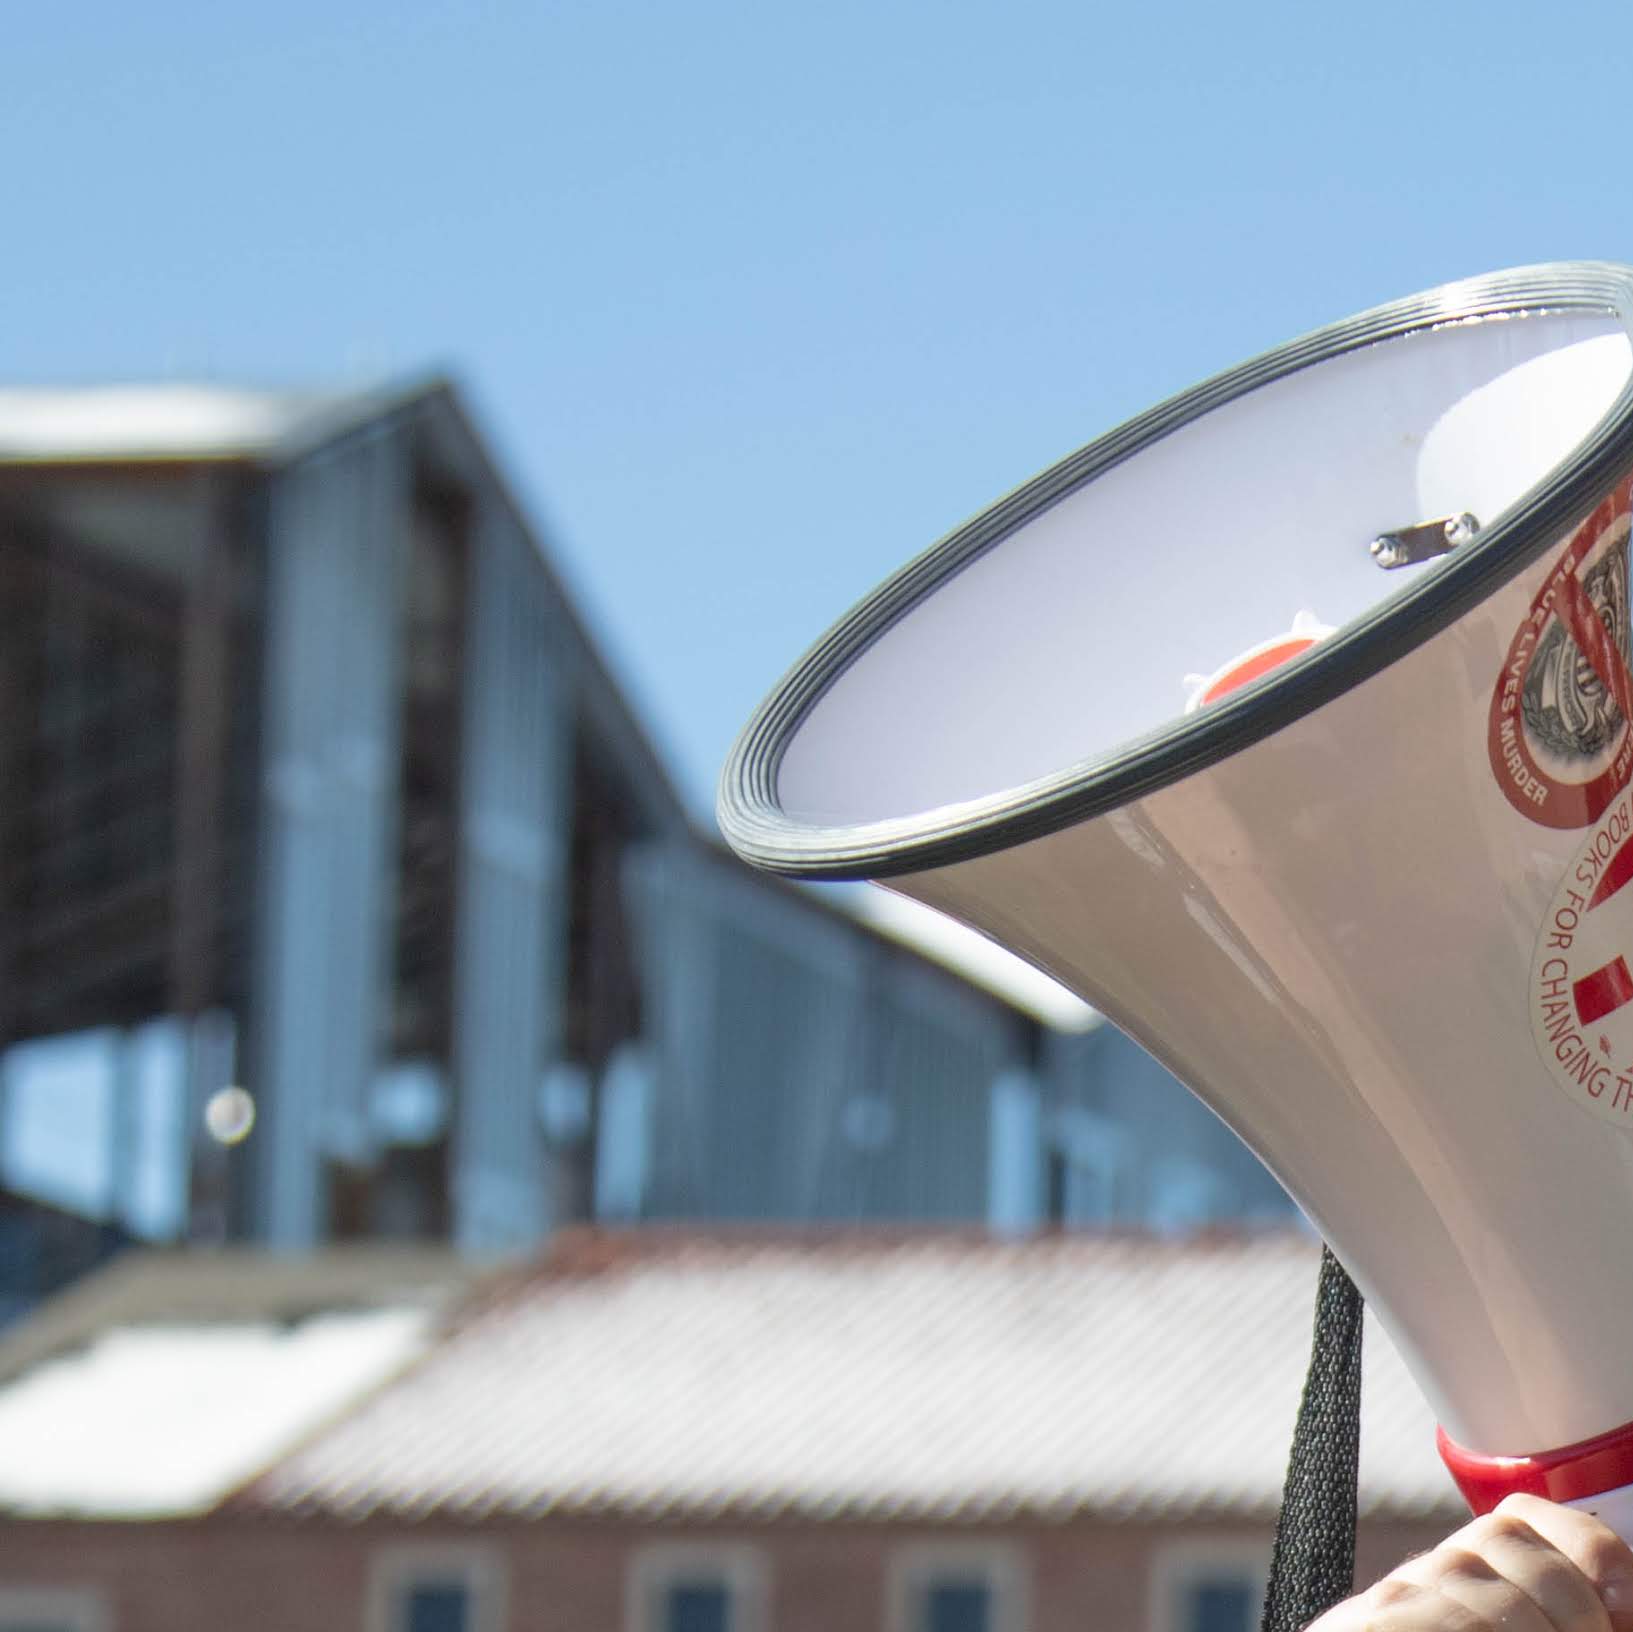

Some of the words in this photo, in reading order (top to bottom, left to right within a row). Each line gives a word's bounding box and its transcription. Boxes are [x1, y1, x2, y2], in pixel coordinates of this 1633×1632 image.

[1530, 553, 1576, 624] BLUE
[1501, 631, 1536, 713] LIVES
[1500, 717, 1549, 806] MURDER
[1576, 801, 1630, 889] BOOKS
[1547, 889, 1585, 949] FOR
[1540, 958, 1612, 1098] CHANGING
